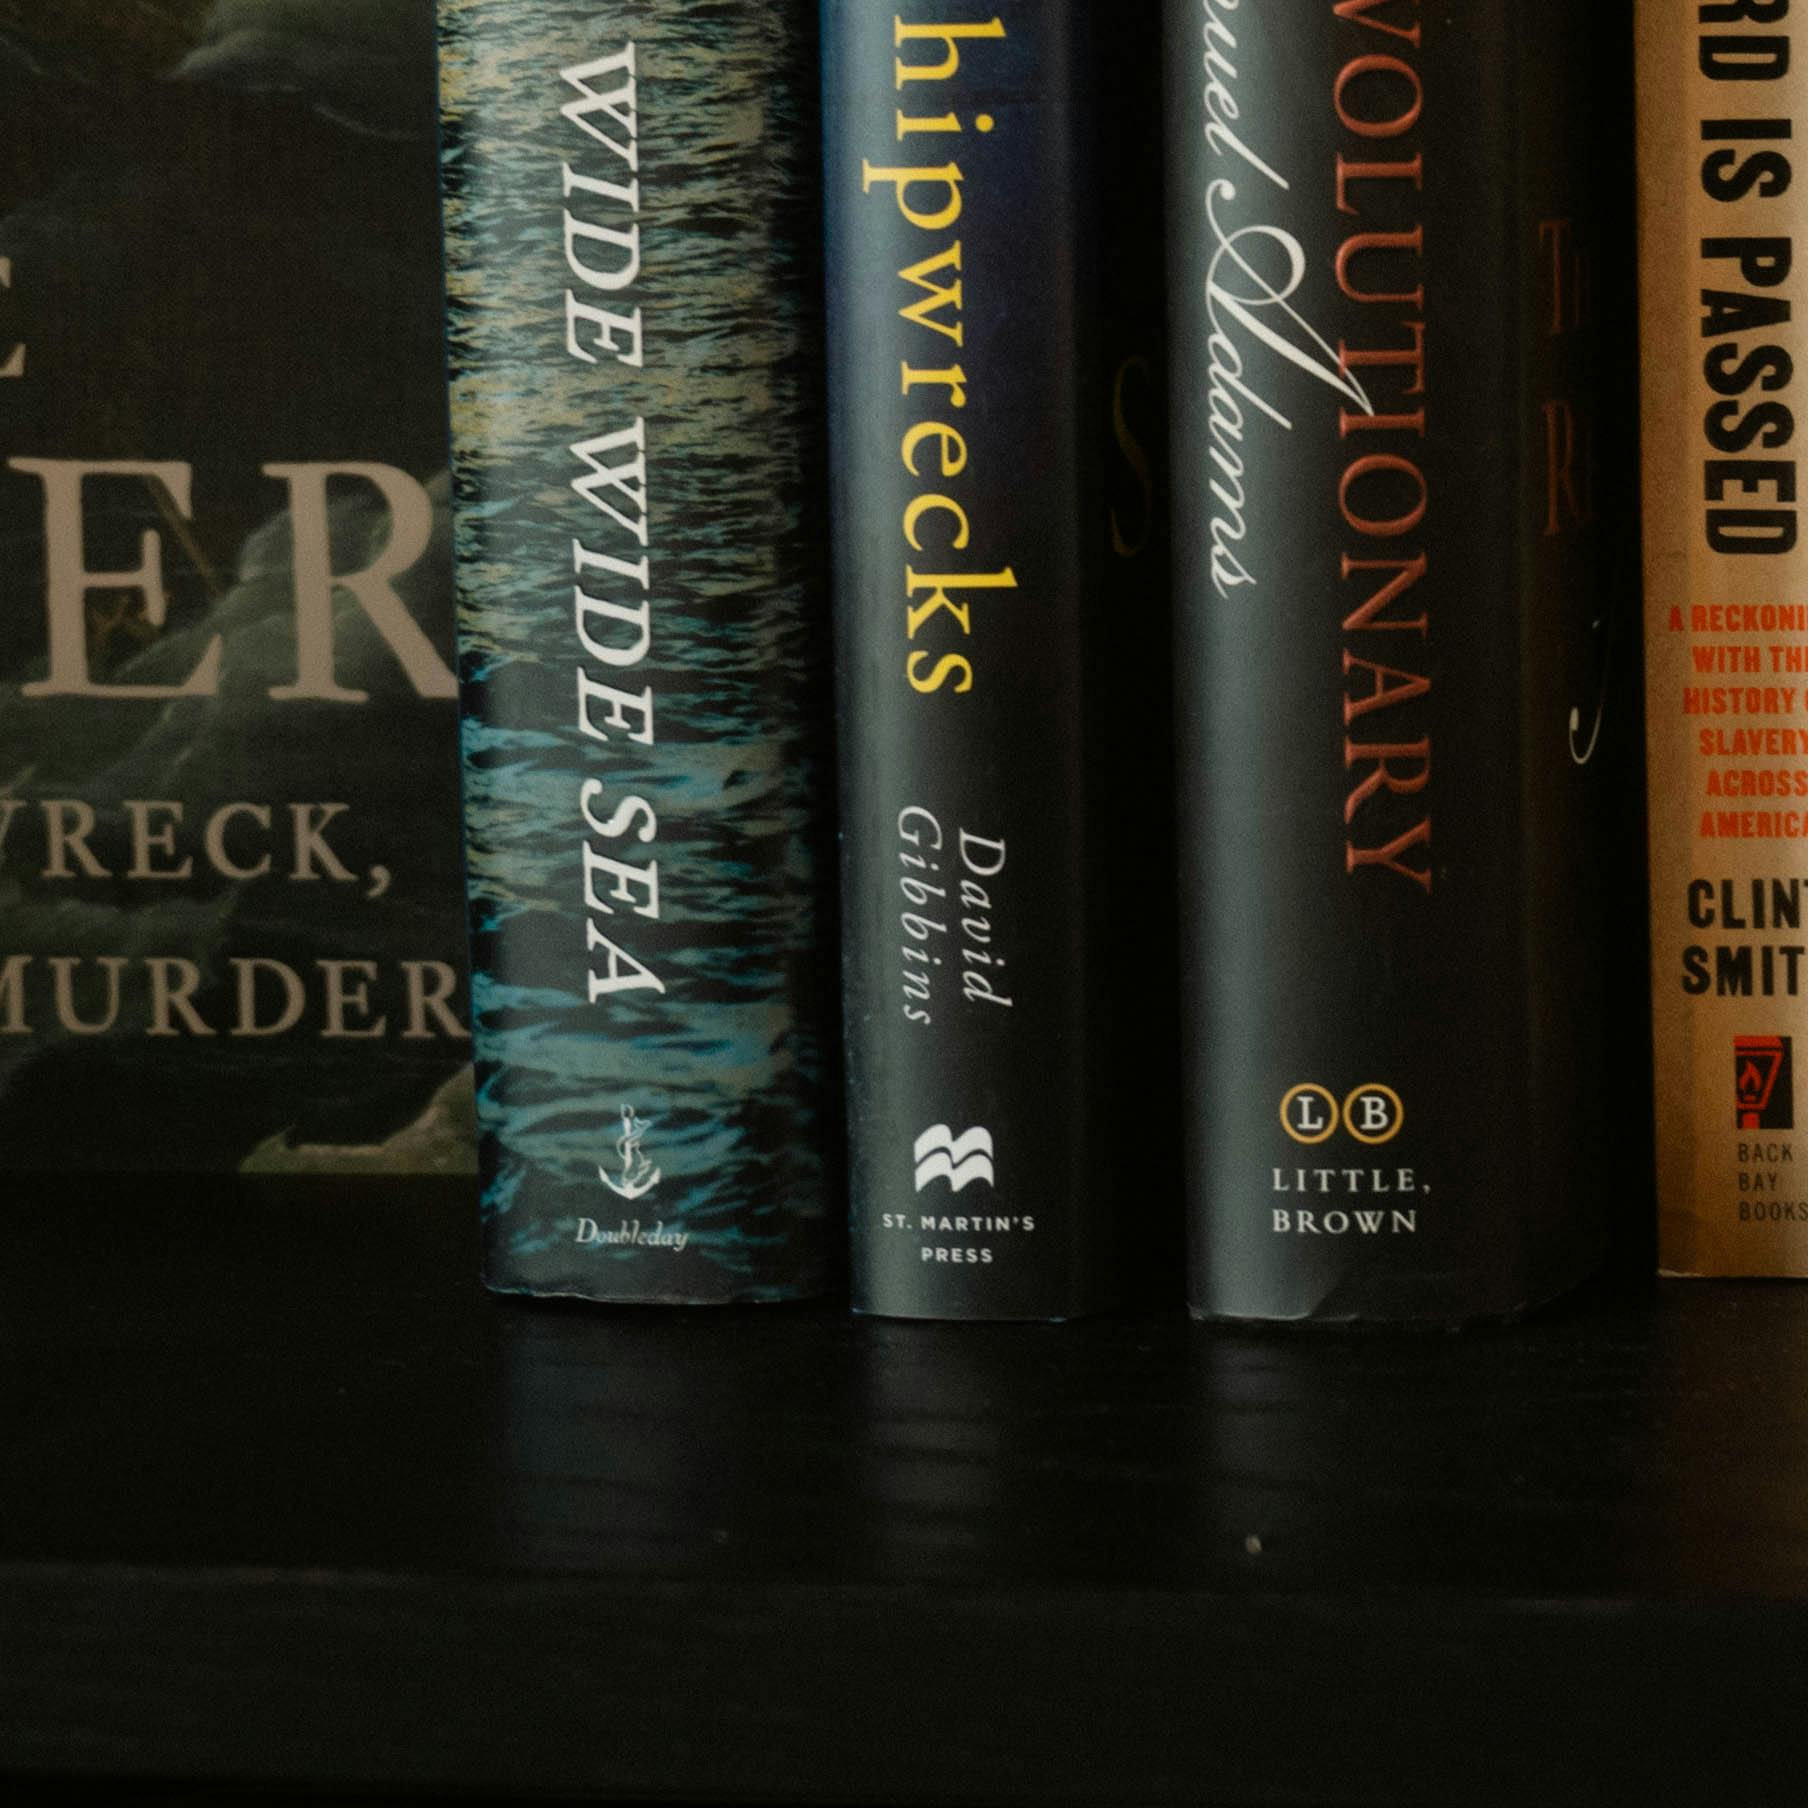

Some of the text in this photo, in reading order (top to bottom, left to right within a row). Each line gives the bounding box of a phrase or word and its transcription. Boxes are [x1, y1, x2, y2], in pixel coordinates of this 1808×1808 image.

[1699, 118, 1792, 202] IS
[558, 42, 645, 369] WIDE
[1204, 177, 1376, 600] Adams
[1699, 236, 1797, 556] PASSED
[568, 416, 655, 746] WIDE
[1668, 604, 1685, 632] A
[1692, 645, 1761, 673] WITH
[1683, 686, 1796, 715] HISTORY
[578, 777, 667, 1005] SEA
[896, 803, 943, 1026] Gibbins
[957, 826, 1014, 1009] David
[1272, 1168, 1432, 1196] LITTLE,
[574, 1217, 690, 1251] Doubleday
[881, 1212, 1036, 1232] ST. MARTIN'S
[1272, 1208, 1417, 1233] BROWN
[920, 1246, 994, 1264] PRESS
